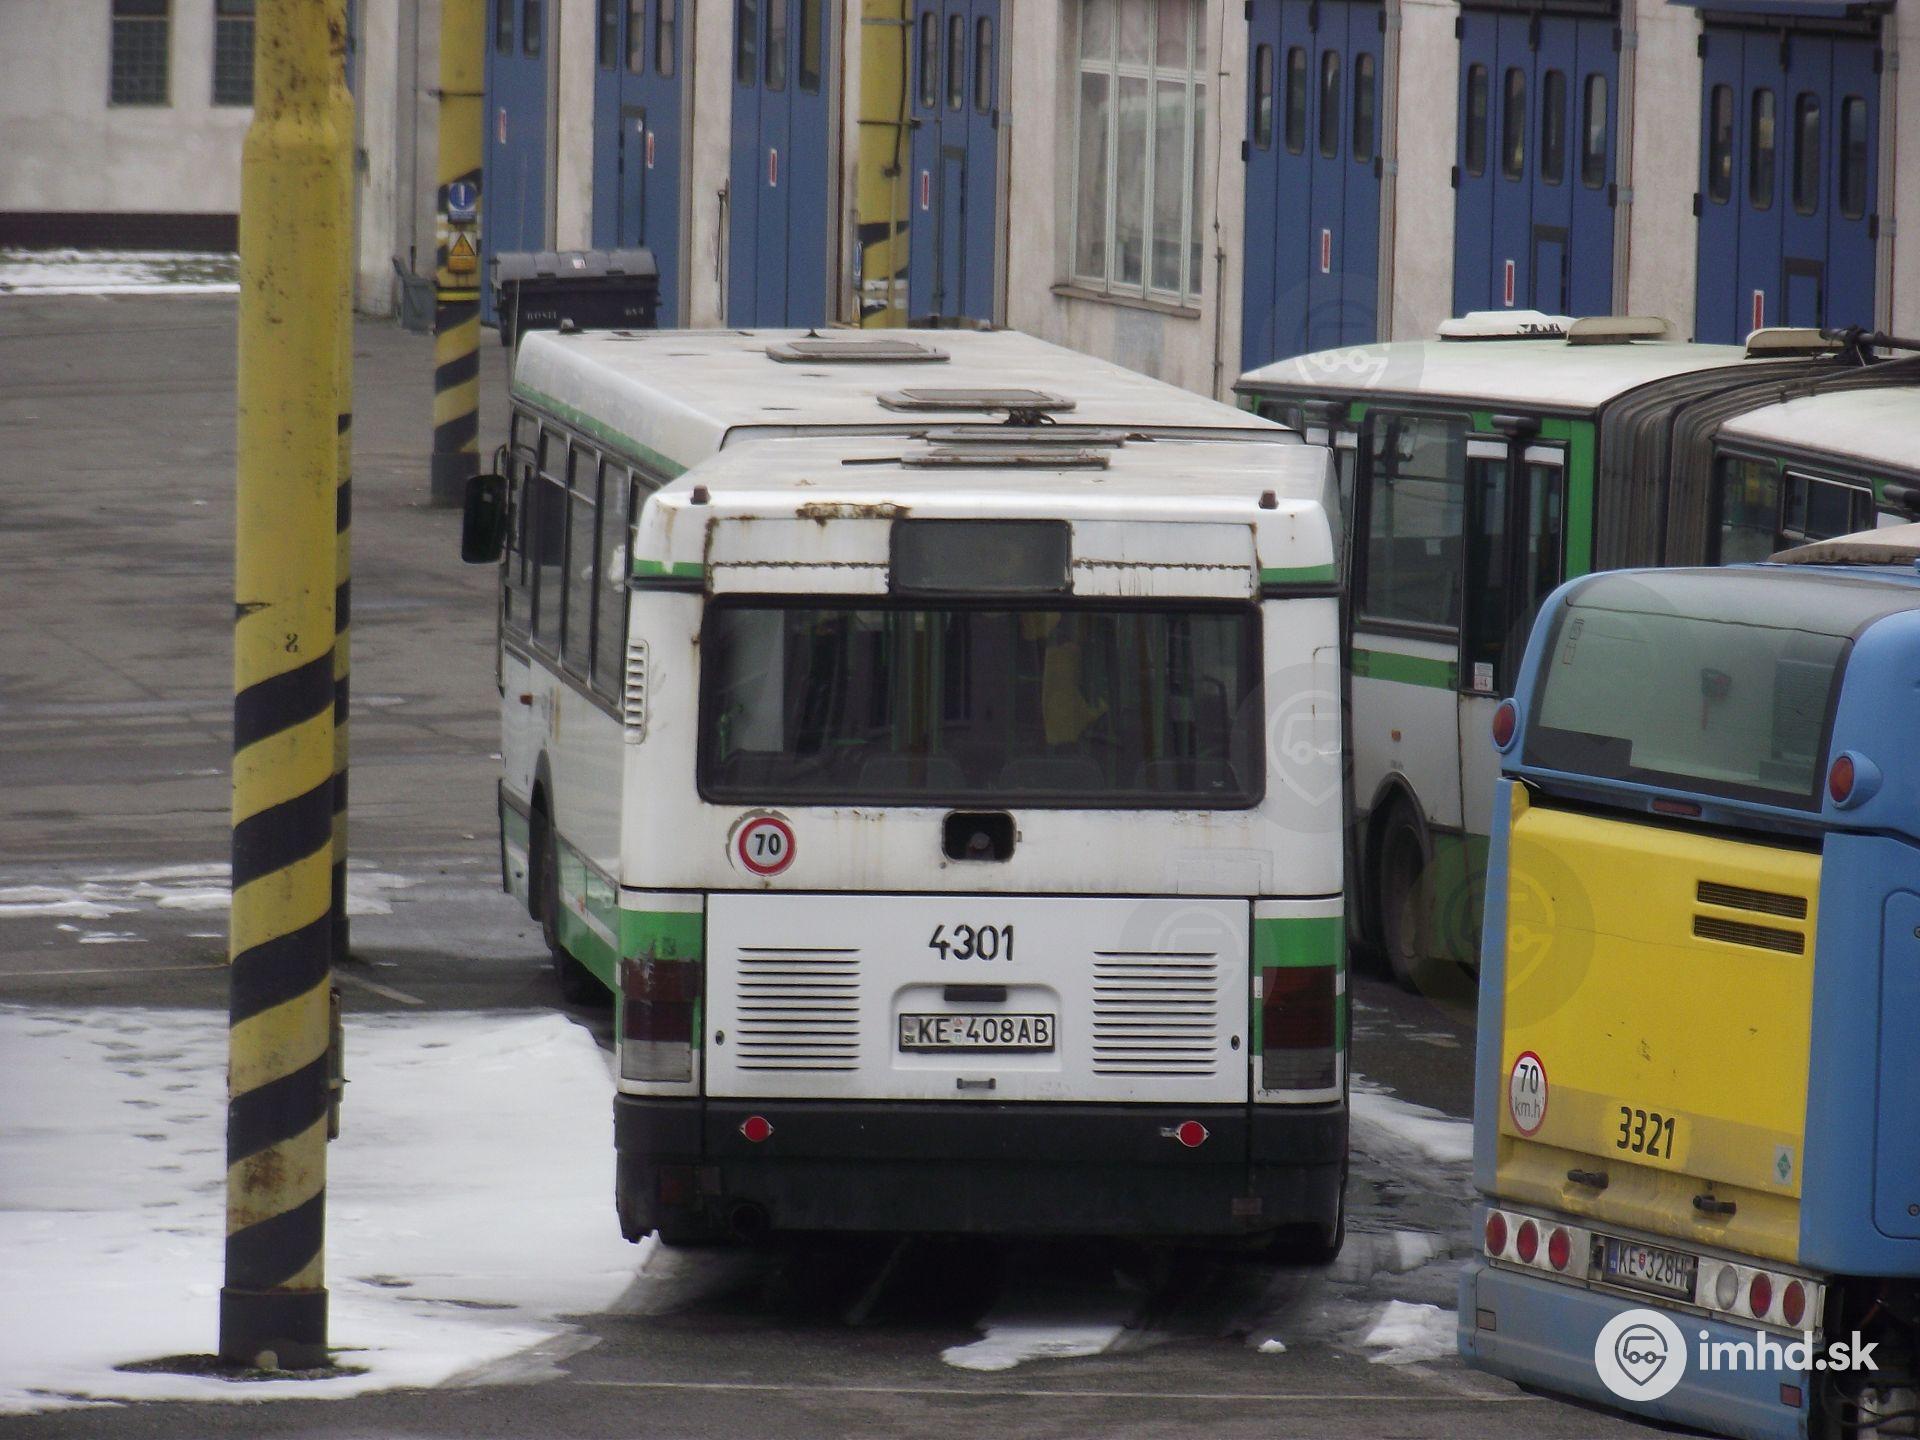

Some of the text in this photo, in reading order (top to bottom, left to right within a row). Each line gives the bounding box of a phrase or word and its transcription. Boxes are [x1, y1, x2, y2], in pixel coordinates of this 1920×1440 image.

[755, 833, 781, 856] 70
[929, 924, 1014, 961] 4301
[1519, 1064, 1539, 1094] 70
[1616, 1106, 1676, 1159] 3321
